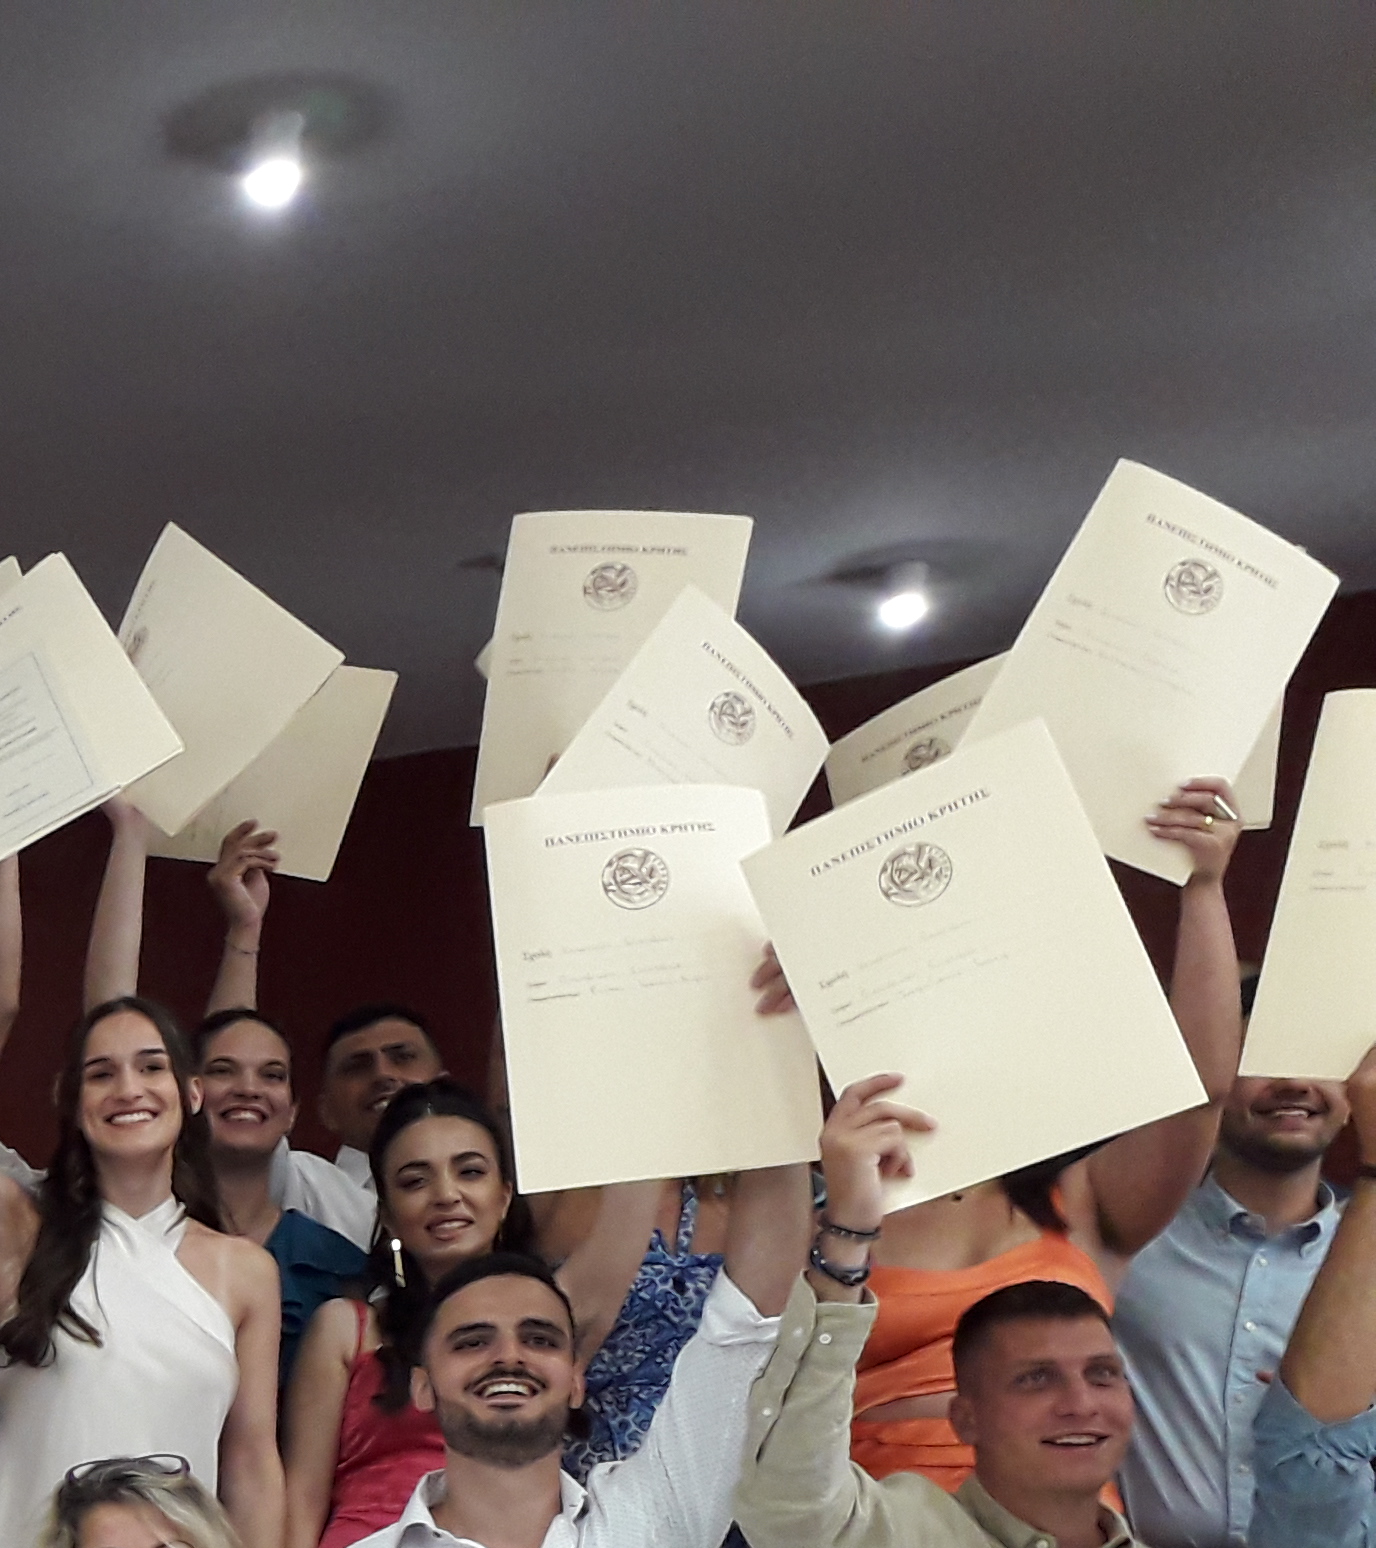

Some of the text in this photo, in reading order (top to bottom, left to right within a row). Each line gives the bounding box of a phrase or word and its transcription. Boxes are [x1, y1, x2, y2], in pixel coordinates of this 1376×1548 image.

[927, 787, 991, 823] ΚΡΗΤΗΣ
[544, 821, 717, 848] ΠΑΝΕΠΙΣΤΗΜΙΟ ΚΡΗΤΗΣ
